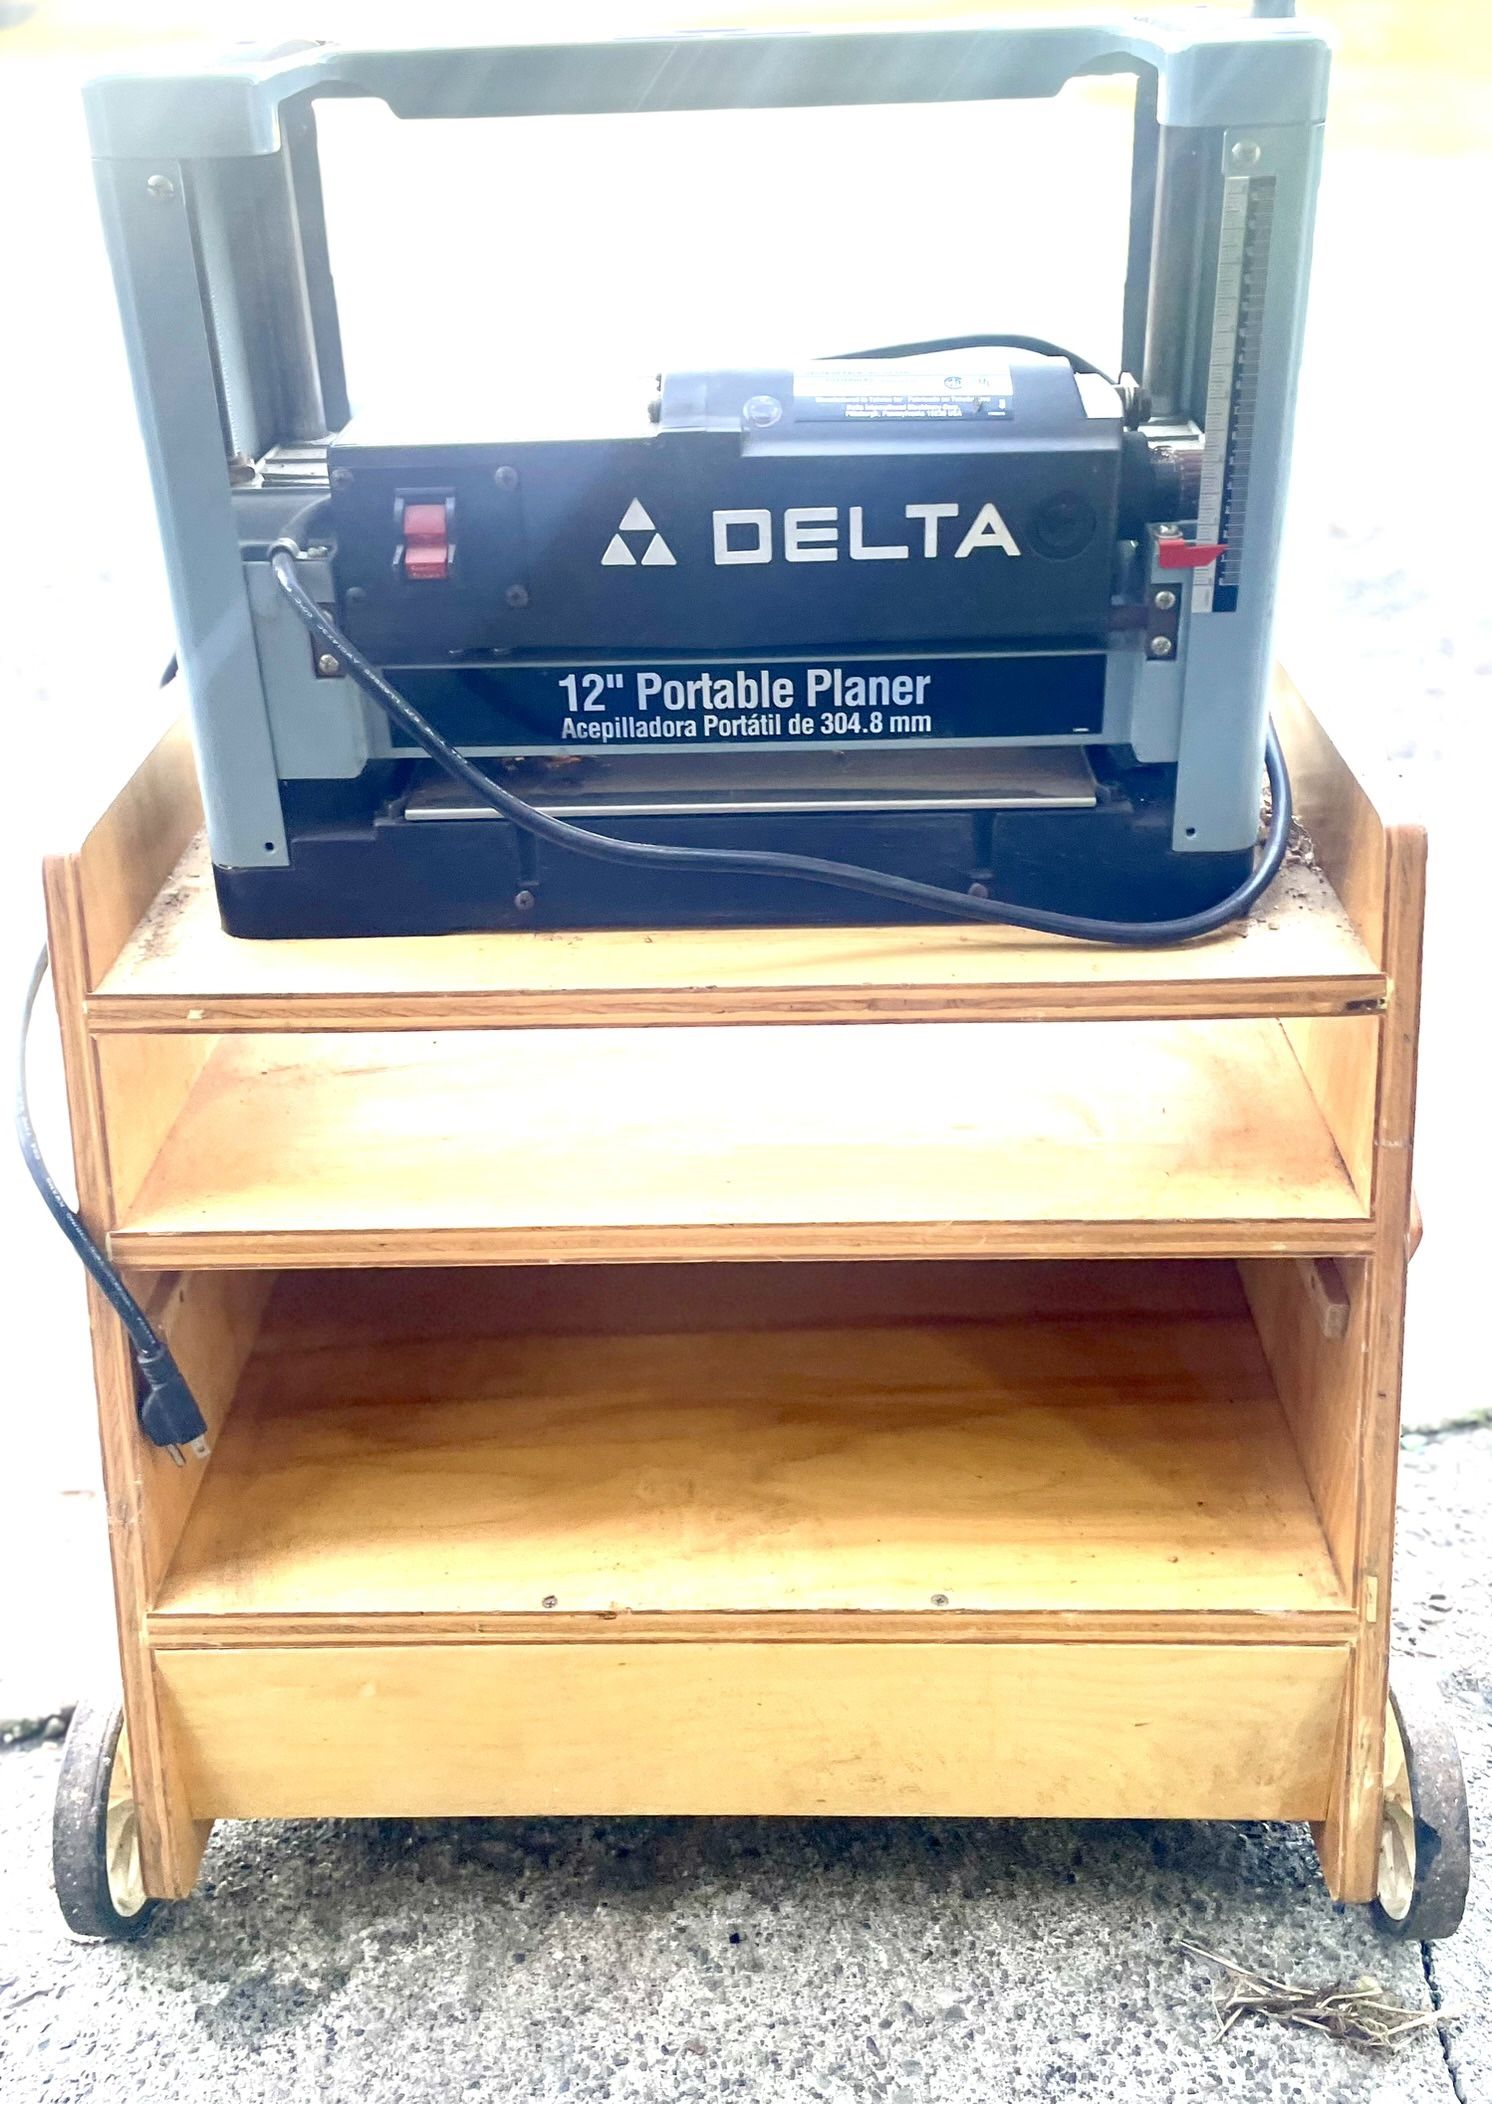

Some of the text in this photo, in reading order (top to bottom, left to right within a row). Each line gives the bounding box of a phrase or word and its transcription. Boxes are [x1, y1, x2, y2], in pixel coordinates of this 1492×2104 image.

[712, 502, 1023, 566] DELTA
[558, 668, 931, 712] 12" Portable Planer
[562, 712, 932, 743] Acepilladora Portátil de 304.8 mm
